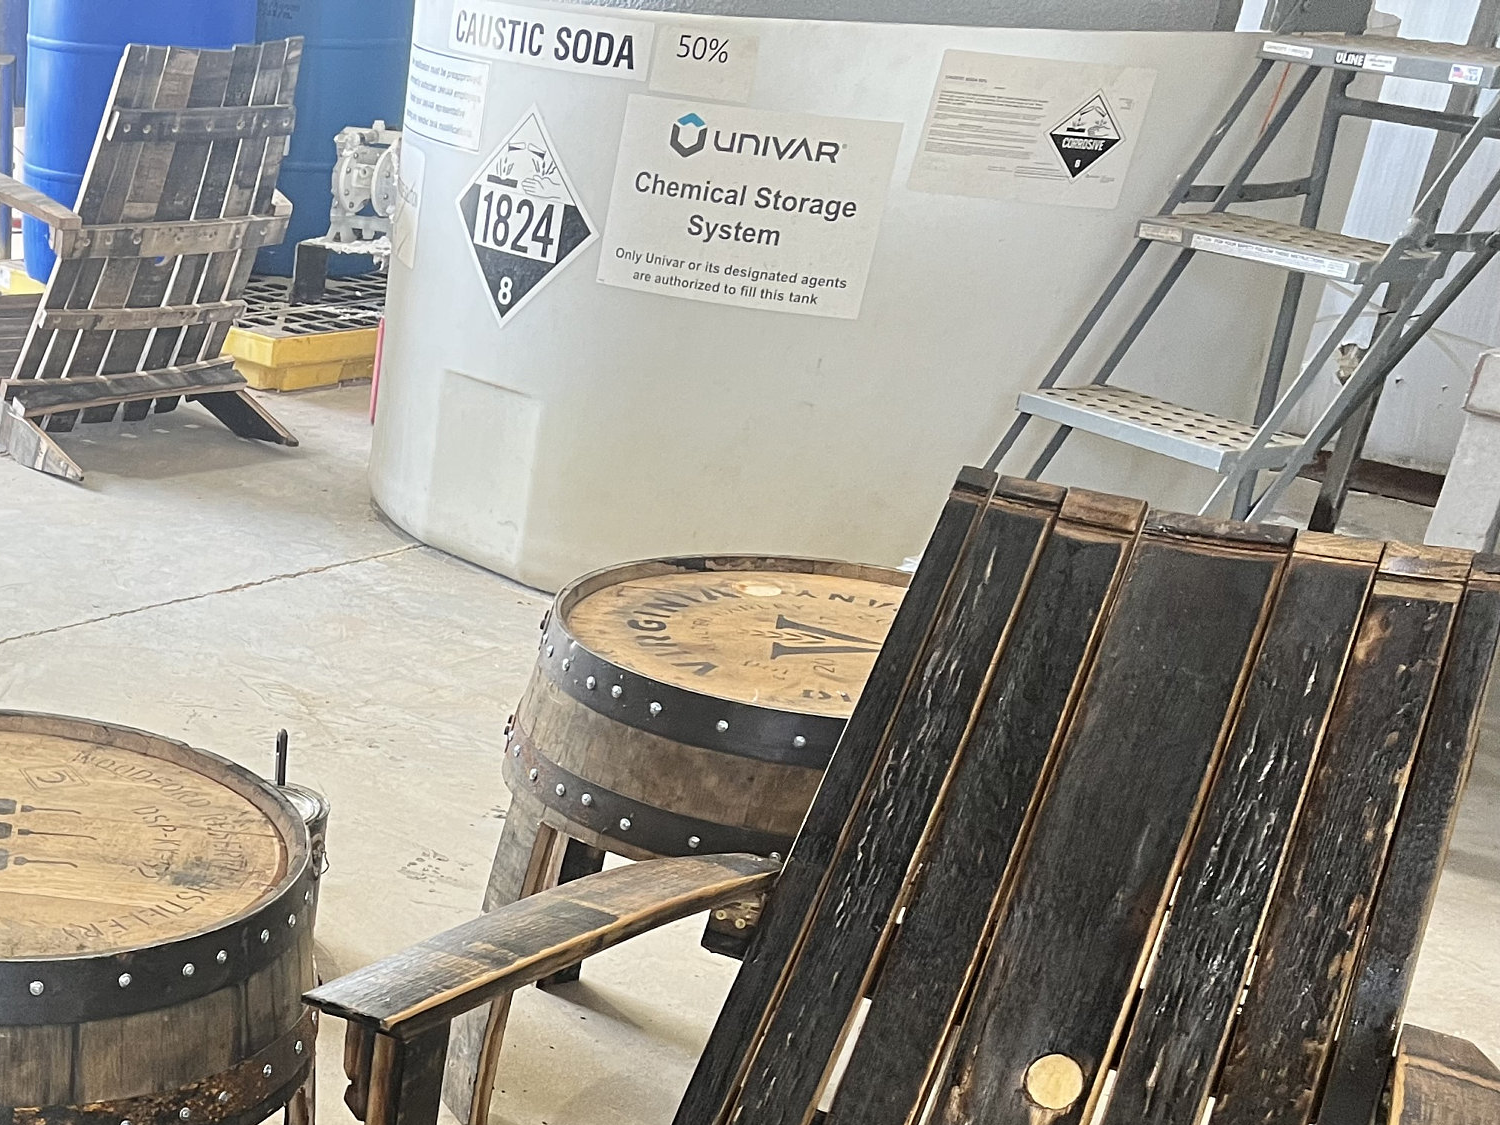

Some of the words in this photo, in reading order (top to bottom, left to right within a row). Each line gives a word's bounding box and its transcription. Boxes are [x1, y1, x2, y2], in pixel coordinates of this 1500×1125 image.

[456, 9, 545, 57] CAUSTIC
[554, 26, 635, 71] SODA
[675, 34, 729, 65] 50%
[1335, 51, 1365, 67] ULINE
[713, 130, 841, 164] UNIVAR
[1062, 137, 1106, 152] CORROSIVE
[635, 171, 747, 206] Chemical
[754, 186, 858, 222] Storage
[482, 190, 555, 258] 1824
[687, 214, 781, 247] System
[615, 247, 643, 265] Only
[645, 252, 686, 269] Univar
[688, 260, 702, 272] or
[704, 262, 720, 275] its
[724, 264, 798, 284] designated
[801, 275, 848, 290] agents
[497, 276, 513, 305] 8
[632, 270, 652, 282] are
[654, 272, 720, 294] authorized
[723, 283, 737, 296] to
[740, 285, 757, 298] fill
[760, 288, 785, 302] this
[788, 291, 819, 306] tank
[626, 587, 742, 676] VIRGINIA
[72, 751, 212, 808] WOODFORD
